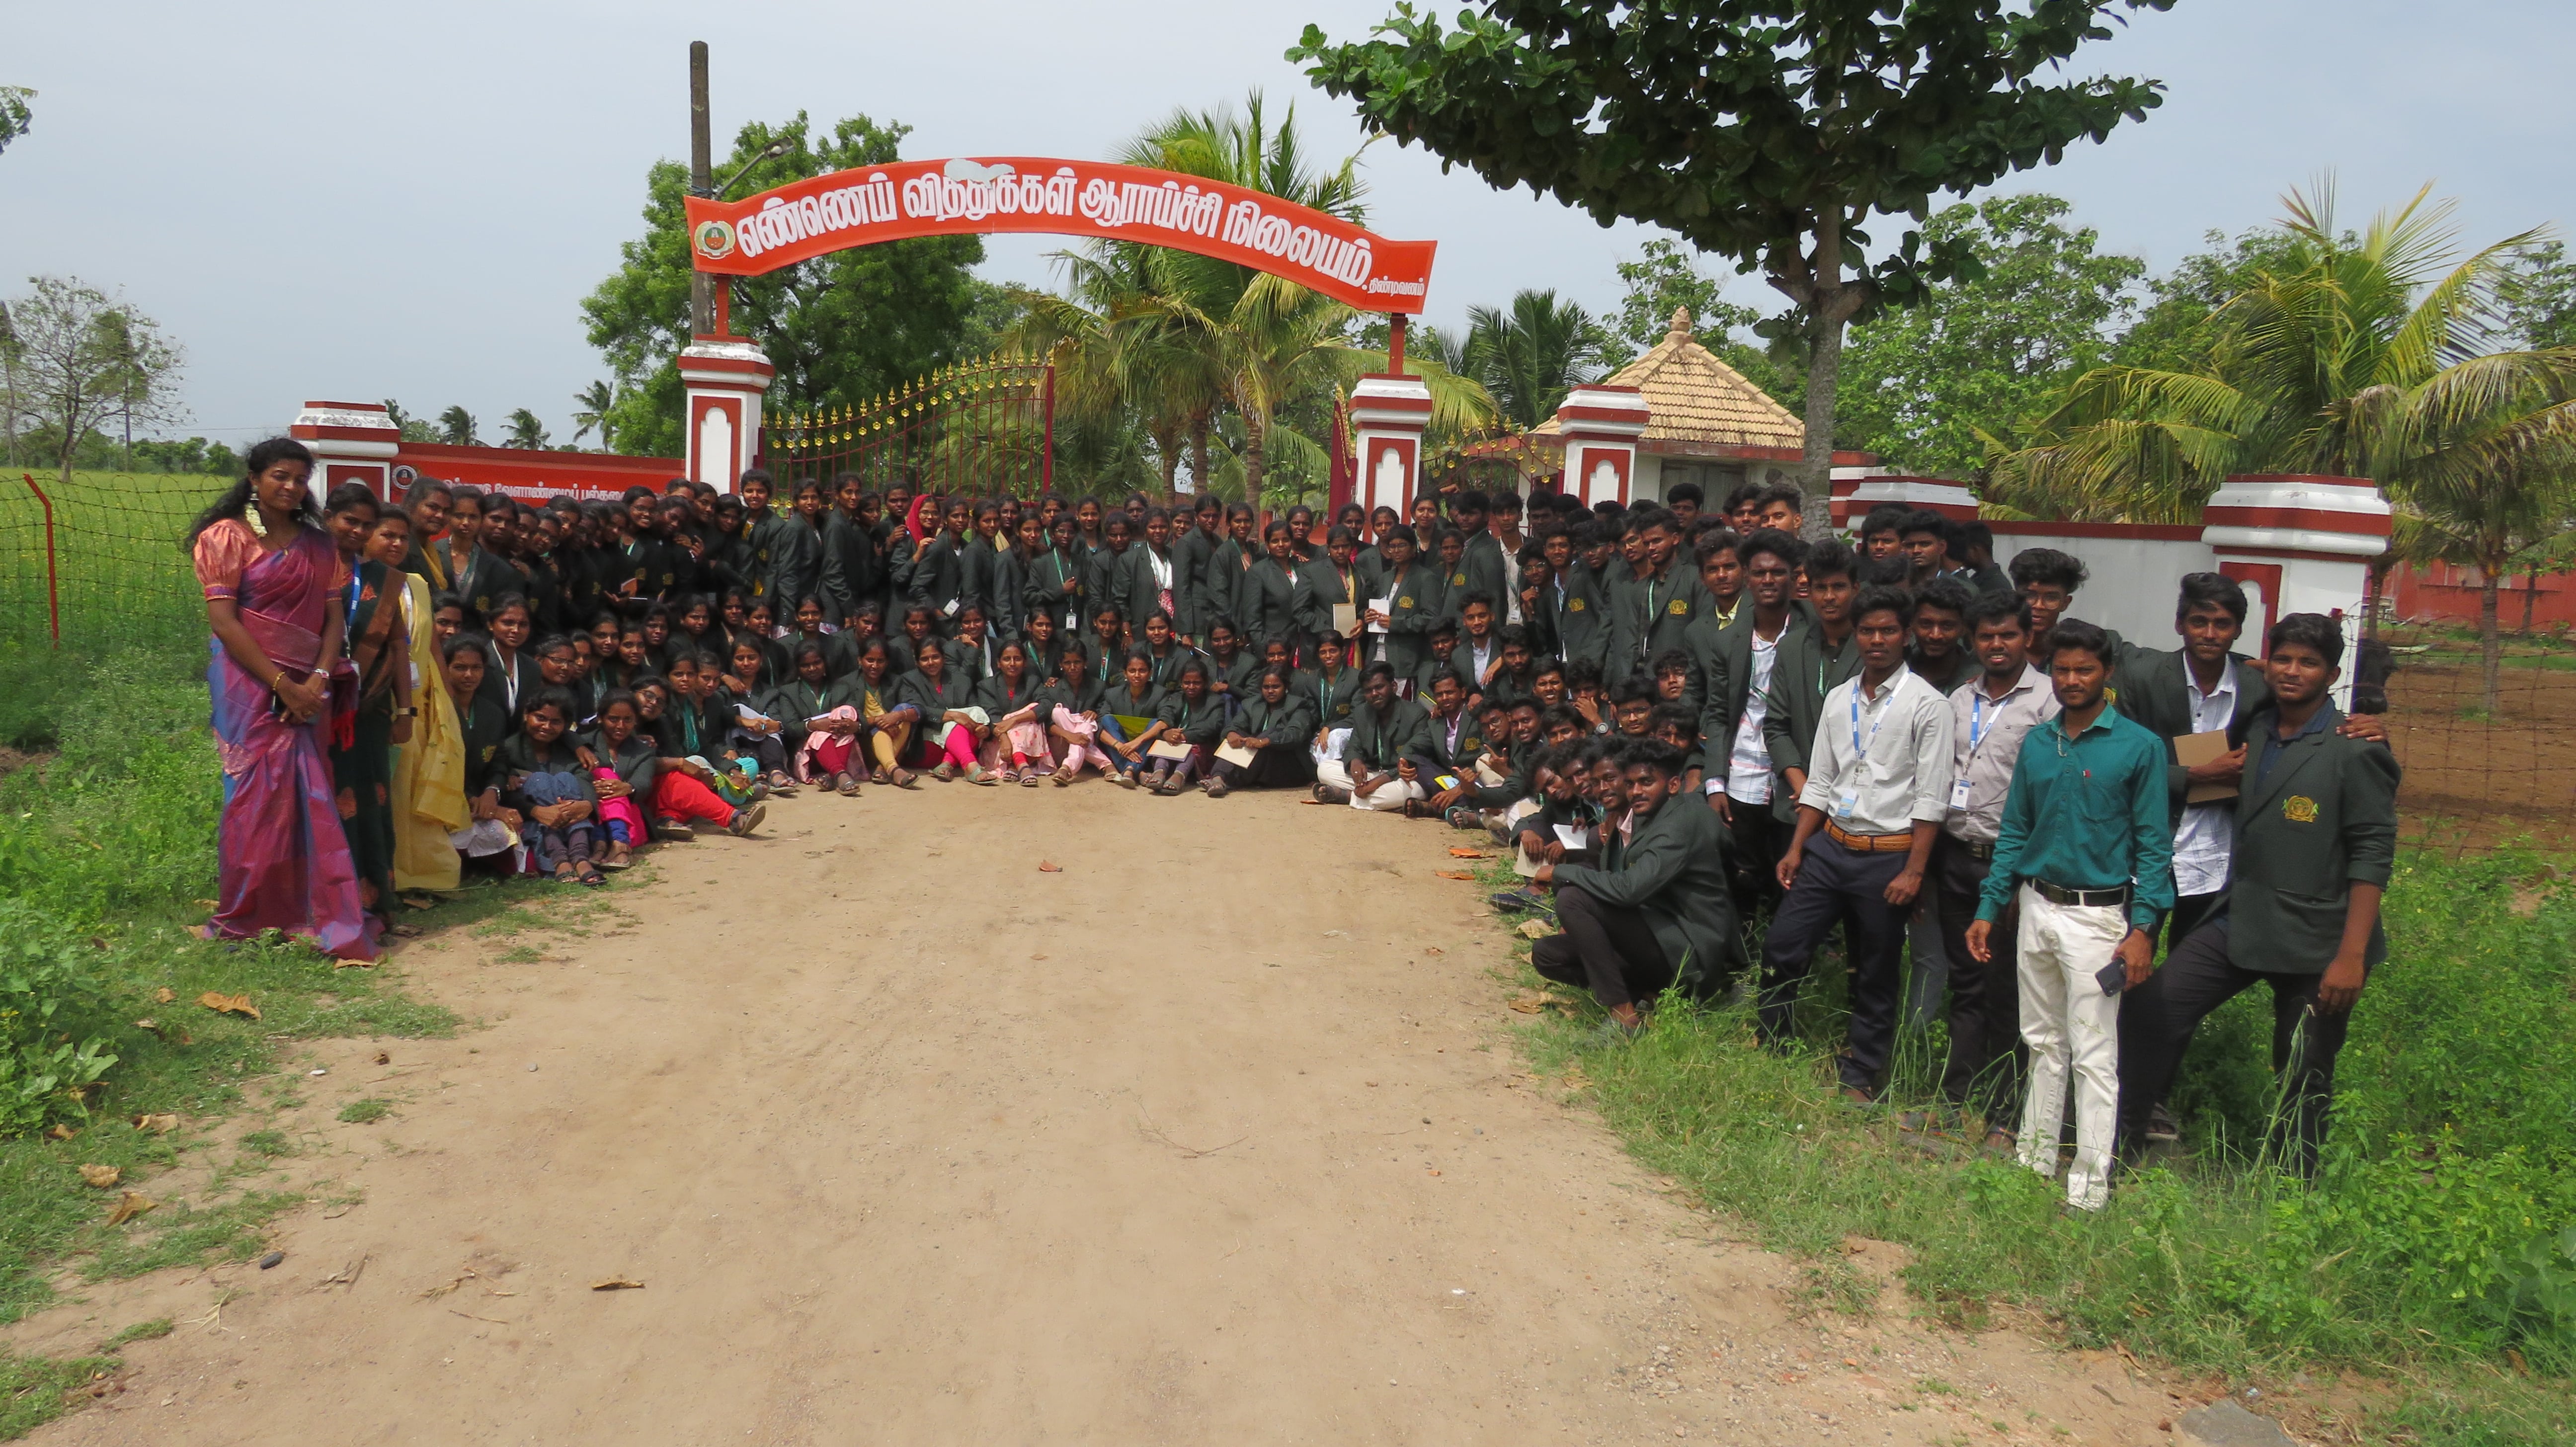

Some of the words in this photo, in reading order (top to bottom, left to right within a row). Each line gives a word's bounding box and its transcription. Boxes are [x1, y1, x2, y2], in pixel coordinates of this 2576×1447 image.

[736, 172, 897, 257] எண்ணெய்
[1079, 180, 1223, 238] ஆராய்ச்சி
[1368, 275, 1425, 297] திண்டிவனம்
